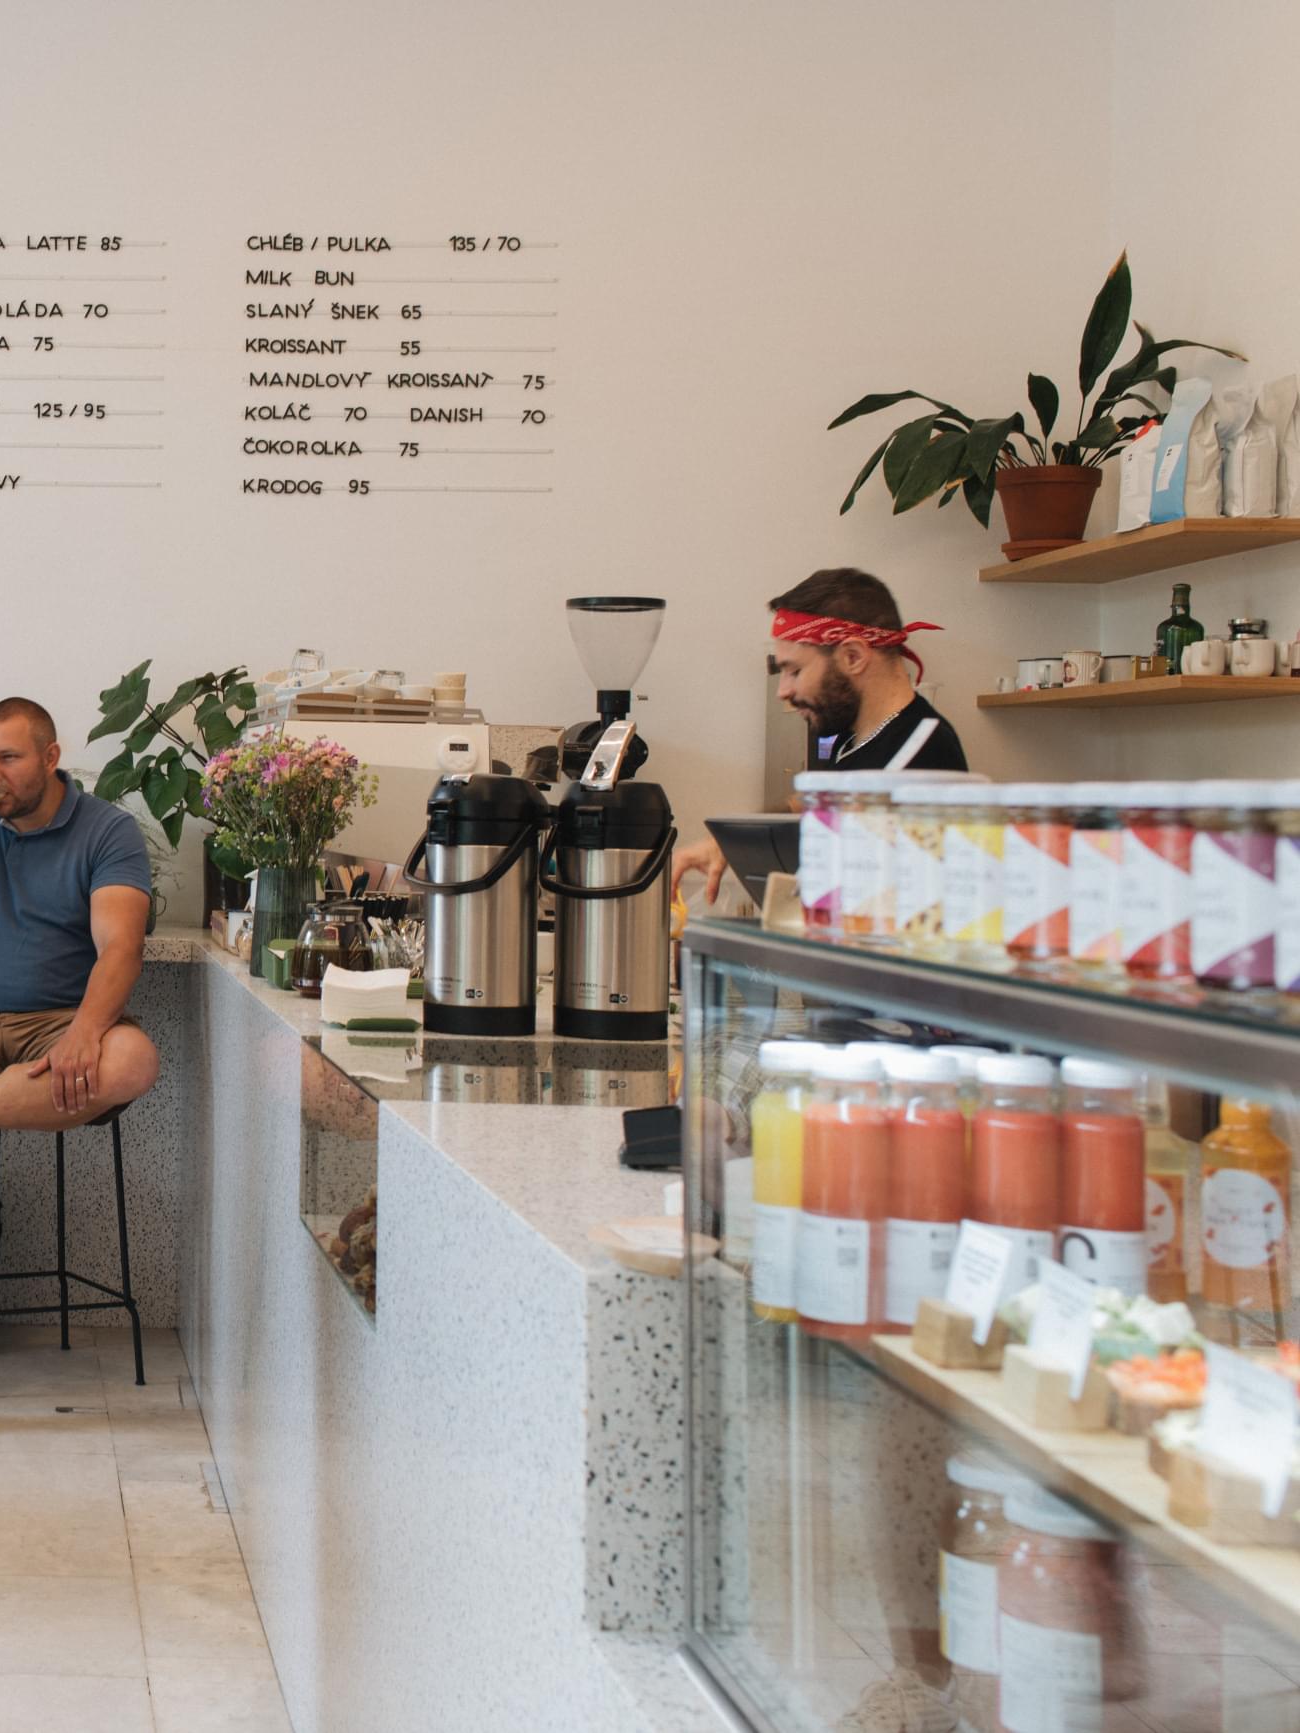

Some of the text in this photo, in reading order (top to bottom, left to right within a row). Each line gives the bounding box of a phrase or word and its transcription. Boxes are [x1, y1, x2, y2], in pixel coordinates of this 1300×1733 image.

[27, 235, 87, 251] LATTE
[101, 236, 122, 251] 85
[247, 233, 303, 252] CHLÉB
[328, 237, 391, 253] PULKA
[498, 236, 521, 251] 70
[246, 270, 354, 287] MILK BUN
[84, 304, 108, 318] 70
[246, 298, 422, 320] SLANÝ ŠNEK 65
[34, 337, 54, 351] 75
[246, 338, 420, 356] KROISSANT 55
[388, 372, 494, 389] KROISSANT
[523, 375, 545, 390] 75
[245, 402, 546, 424] KOLÁČ 70 DANISH 70
[243, 437, 419, 457] ČOKOROLKA 75
[243, 479, 323, 495] KRODOG
